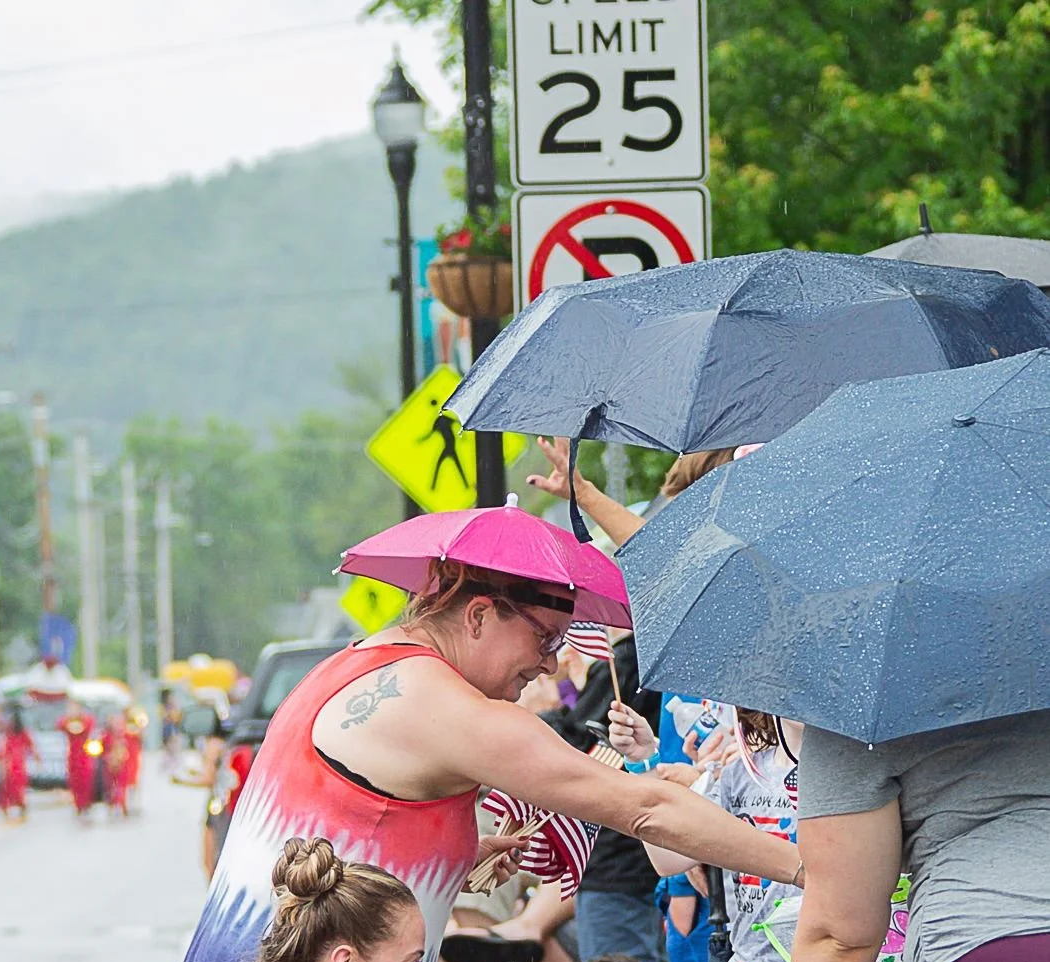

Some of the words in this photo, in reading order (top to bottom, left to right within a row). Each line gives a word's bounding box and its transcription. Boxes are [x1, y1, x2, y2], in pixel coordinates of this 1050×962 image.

[550, 19, 665, 54] LIMIT
[538, 69, 683, 154] 25
[751, 796, 771, 807] LOVE
[748, 888, 767, 901] JULY
